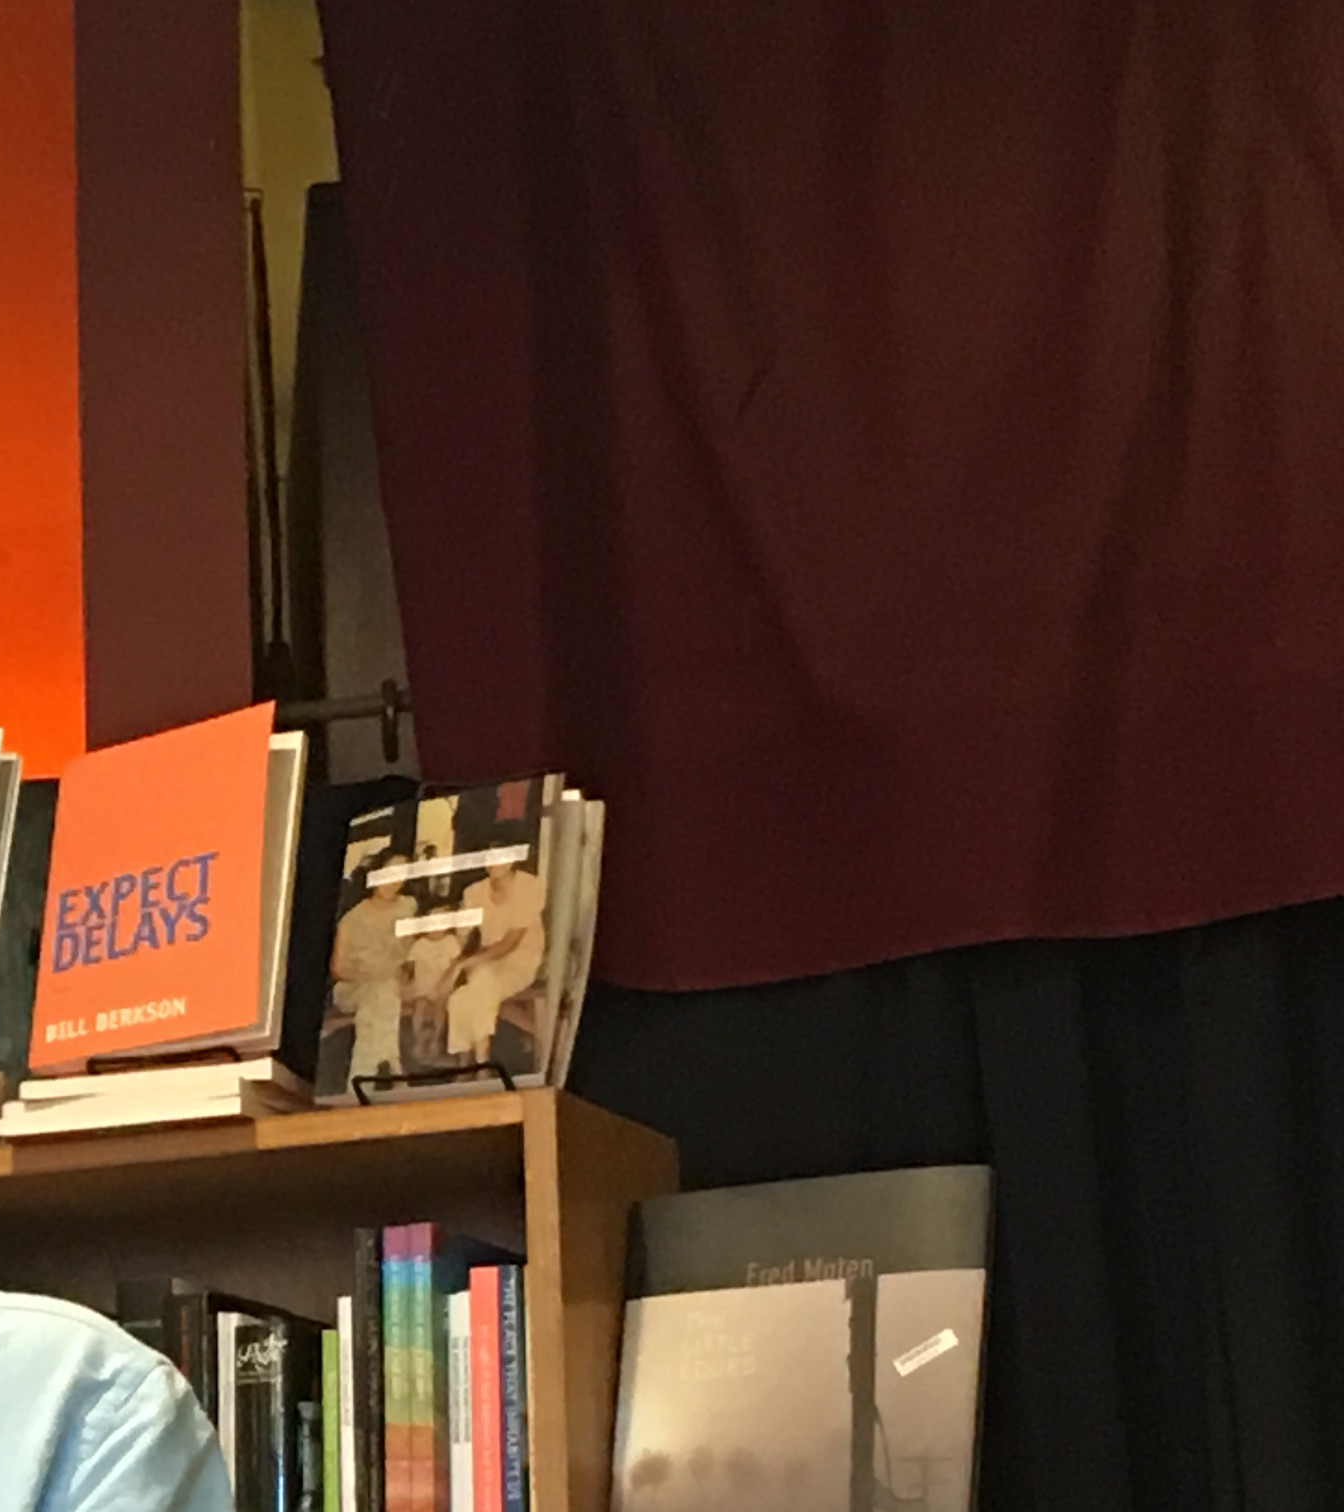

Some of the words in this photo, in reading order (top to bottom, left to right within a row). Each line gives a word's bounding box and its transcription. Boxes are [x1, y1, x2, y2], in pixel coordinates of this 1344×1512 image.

[56, 851, 220, 931] EXPECT
[52, 895, 212, 975] DELAYS
[45, 1020, 87, 1043] BILL
[95, 997, 187, 1033] BERKSON
[745, 1260, 796, 1287] Fred
[804, 1257, 875, 1282] Moten
